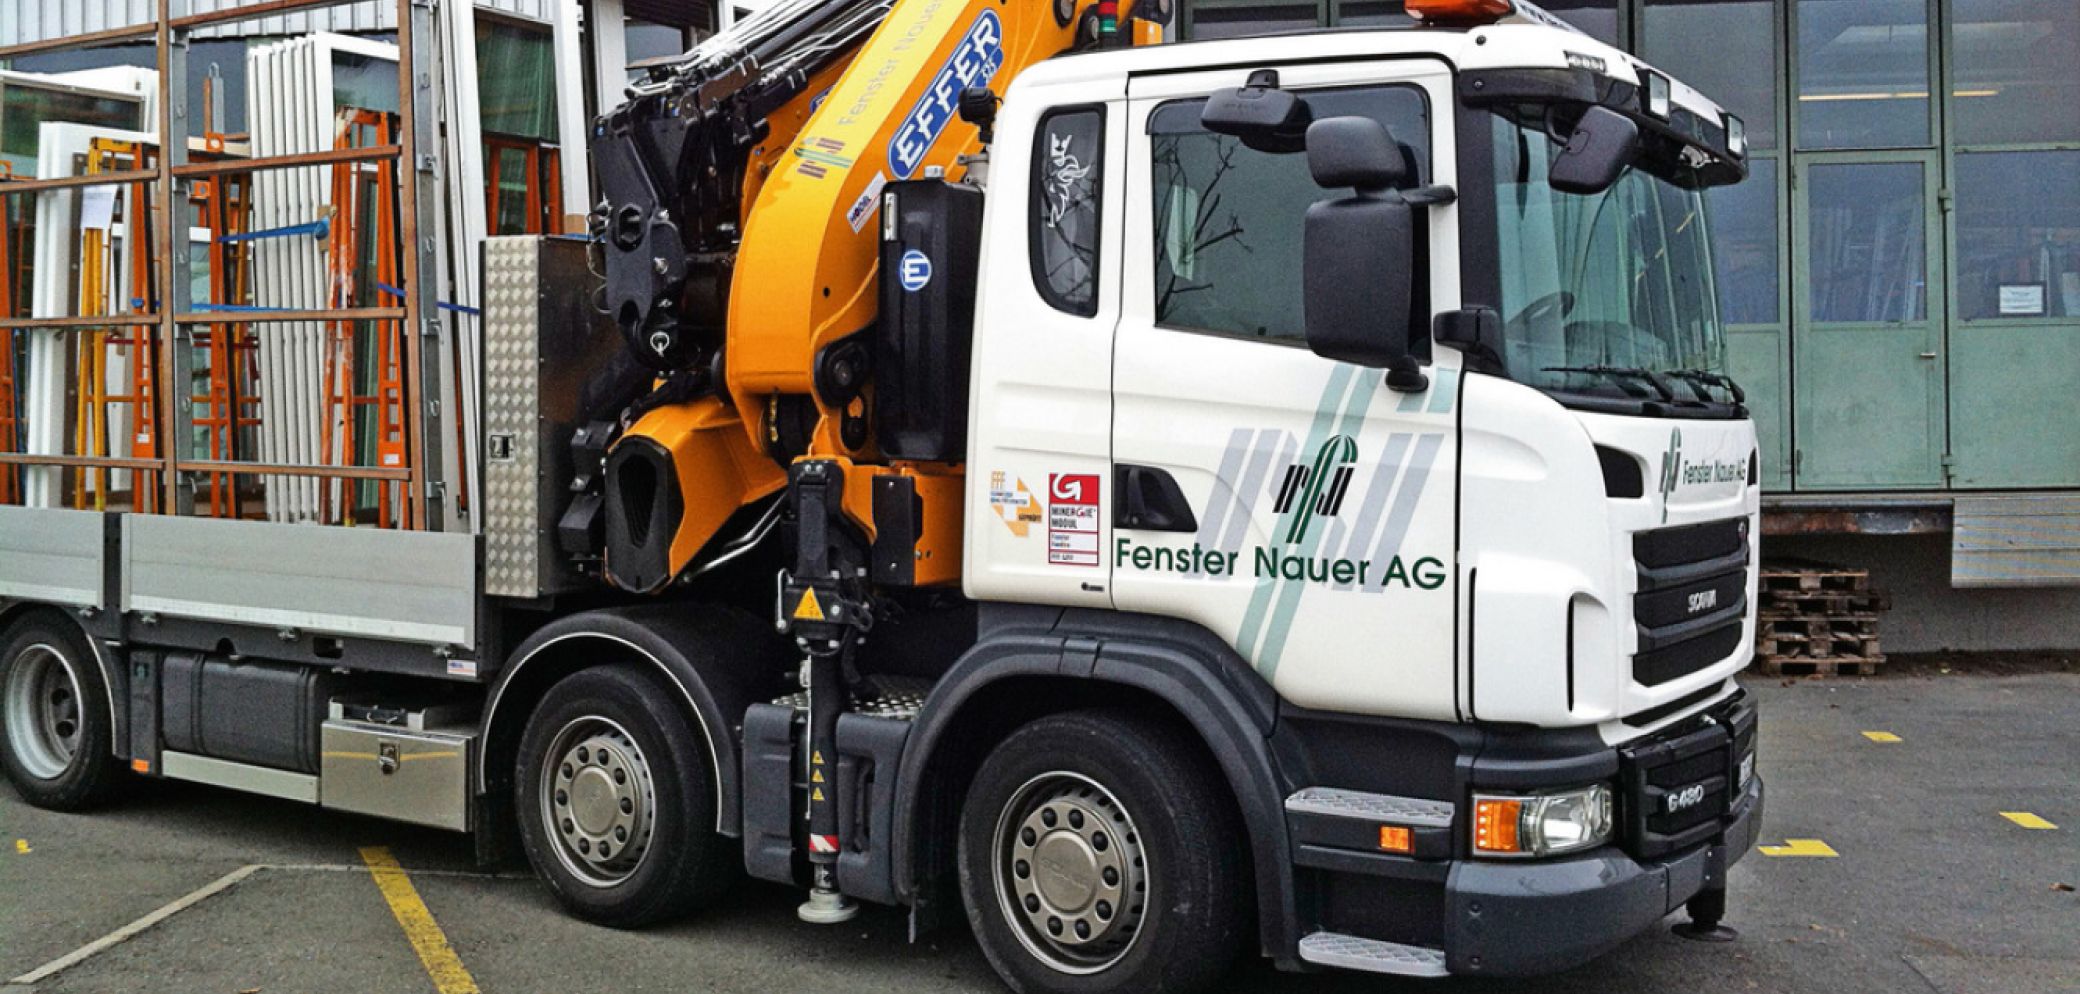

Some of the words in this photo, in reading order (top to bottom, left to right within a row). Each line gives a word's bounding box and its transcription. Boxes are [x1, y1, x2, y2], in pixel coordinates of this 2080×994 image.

[895, 17, 998, 168] EFFER
[904, 258, 928, 282] E
[1682, 459, 1713, 485] Fenster
[1714, 459, 1735, 483] Nauer
[1116, 538, 1239, 576] Fenster
[1254, 546, 1370, 585] Nauer
[1381, 554, 1446, 590] AG
